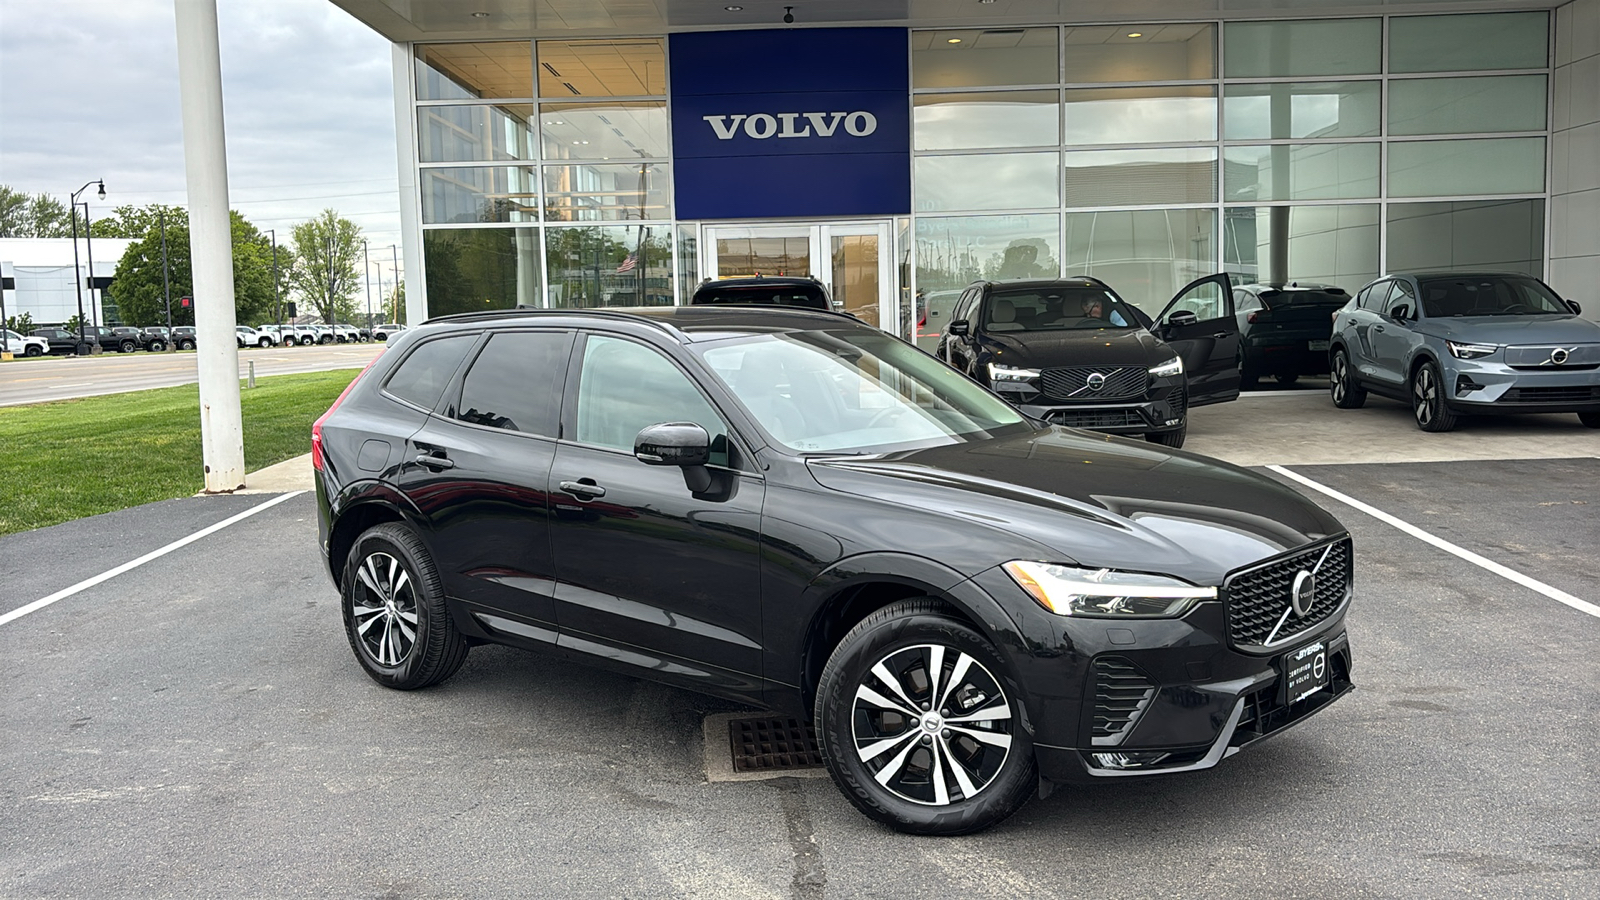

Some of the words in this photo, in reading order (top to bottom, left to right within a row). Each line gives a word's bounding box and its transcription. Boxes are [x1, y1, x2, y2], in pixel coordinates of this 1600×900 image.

[703, 111, 877, 140] VOLVO
[1299, 643, 1320, 659] BYERS
[1296, 673, 1310, 685] VOLVO
[829, 671, 847, 726] ZERO
[829, 731, 887, 814] SCORPION
